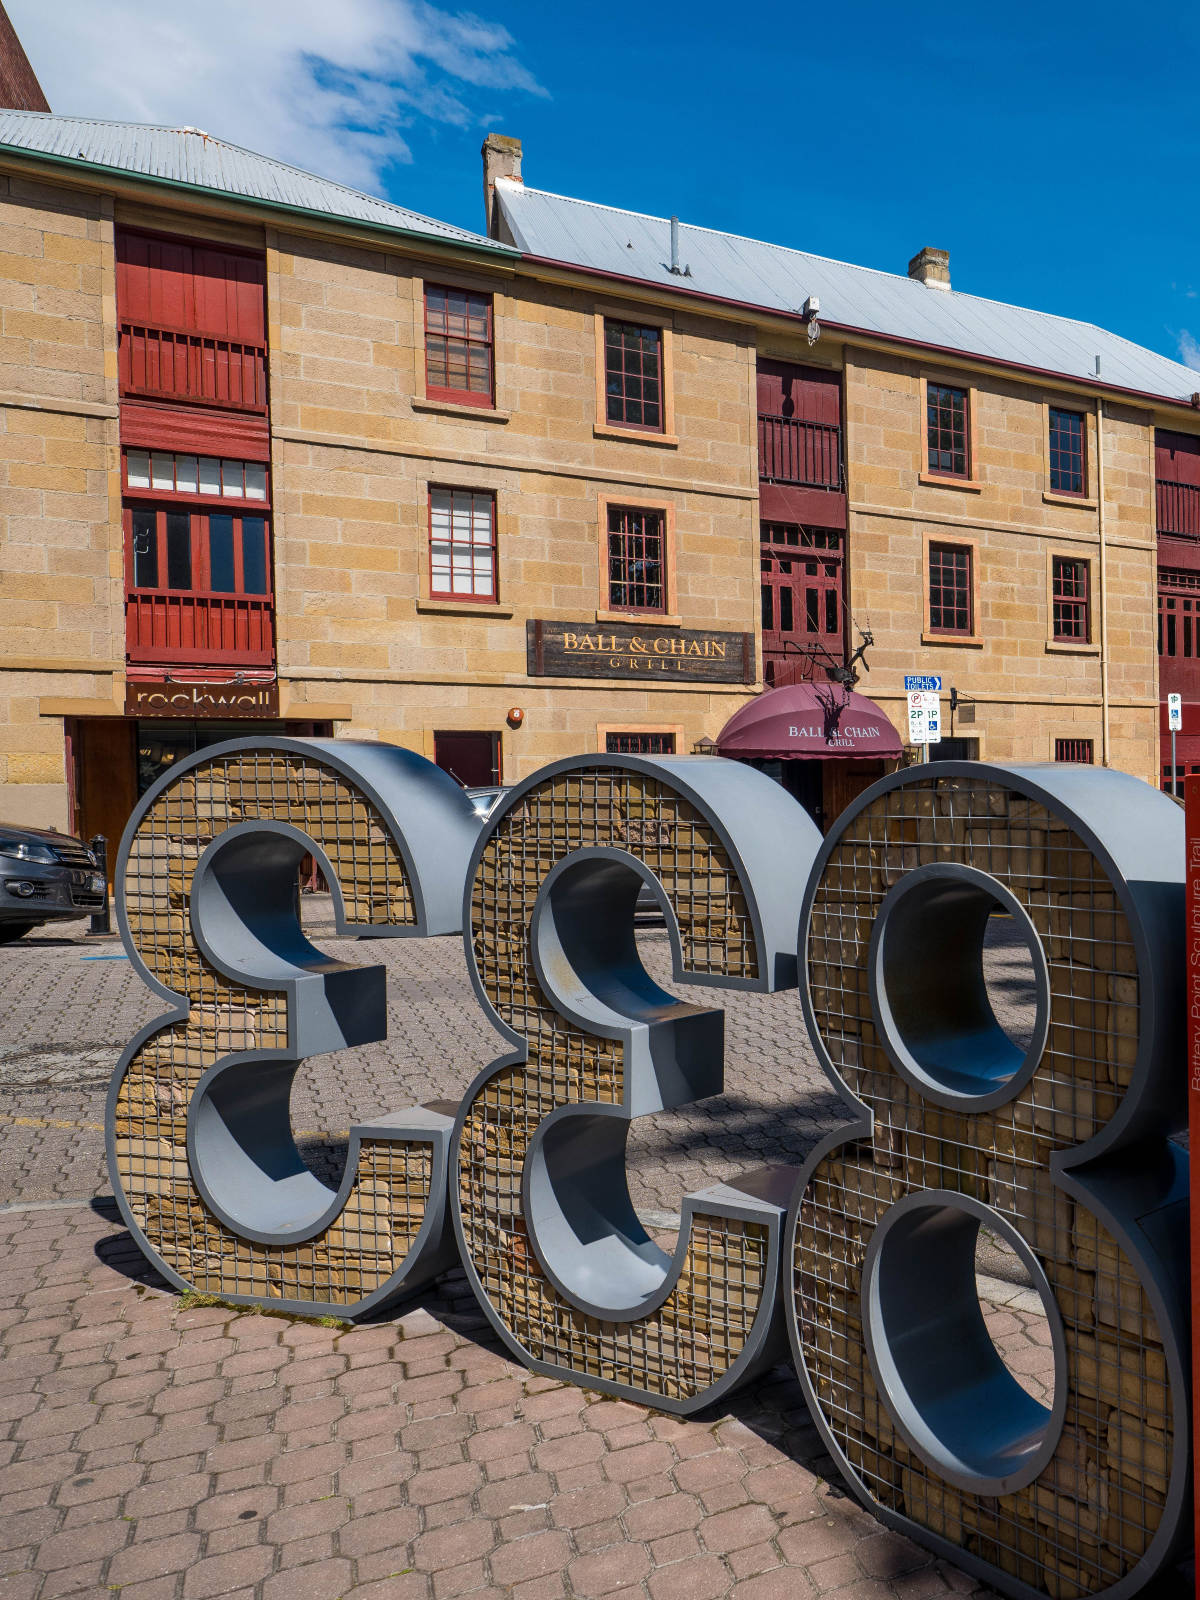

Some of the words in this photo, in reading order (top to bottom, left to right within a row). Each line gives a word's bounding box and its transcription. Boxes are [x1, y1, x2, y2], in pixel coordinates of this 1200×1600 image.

[563, 632, 623, 652] BALL
[629, 636, 649, 653] &
[653, 637, 727, 657] CHAIN
[609, 657, 685, 671] GRILL
[907, 676, 932, 684] PUBLIC
[136, 688, 270, 713] rockwall
[910, 710, 923, 719] 2P
[927, 710, 938, 719] 1P
[789, 726, 825, 737] BALL
[845, 726, 880, 737] CHAIN
[828, 739, 855, 747] GRILL
